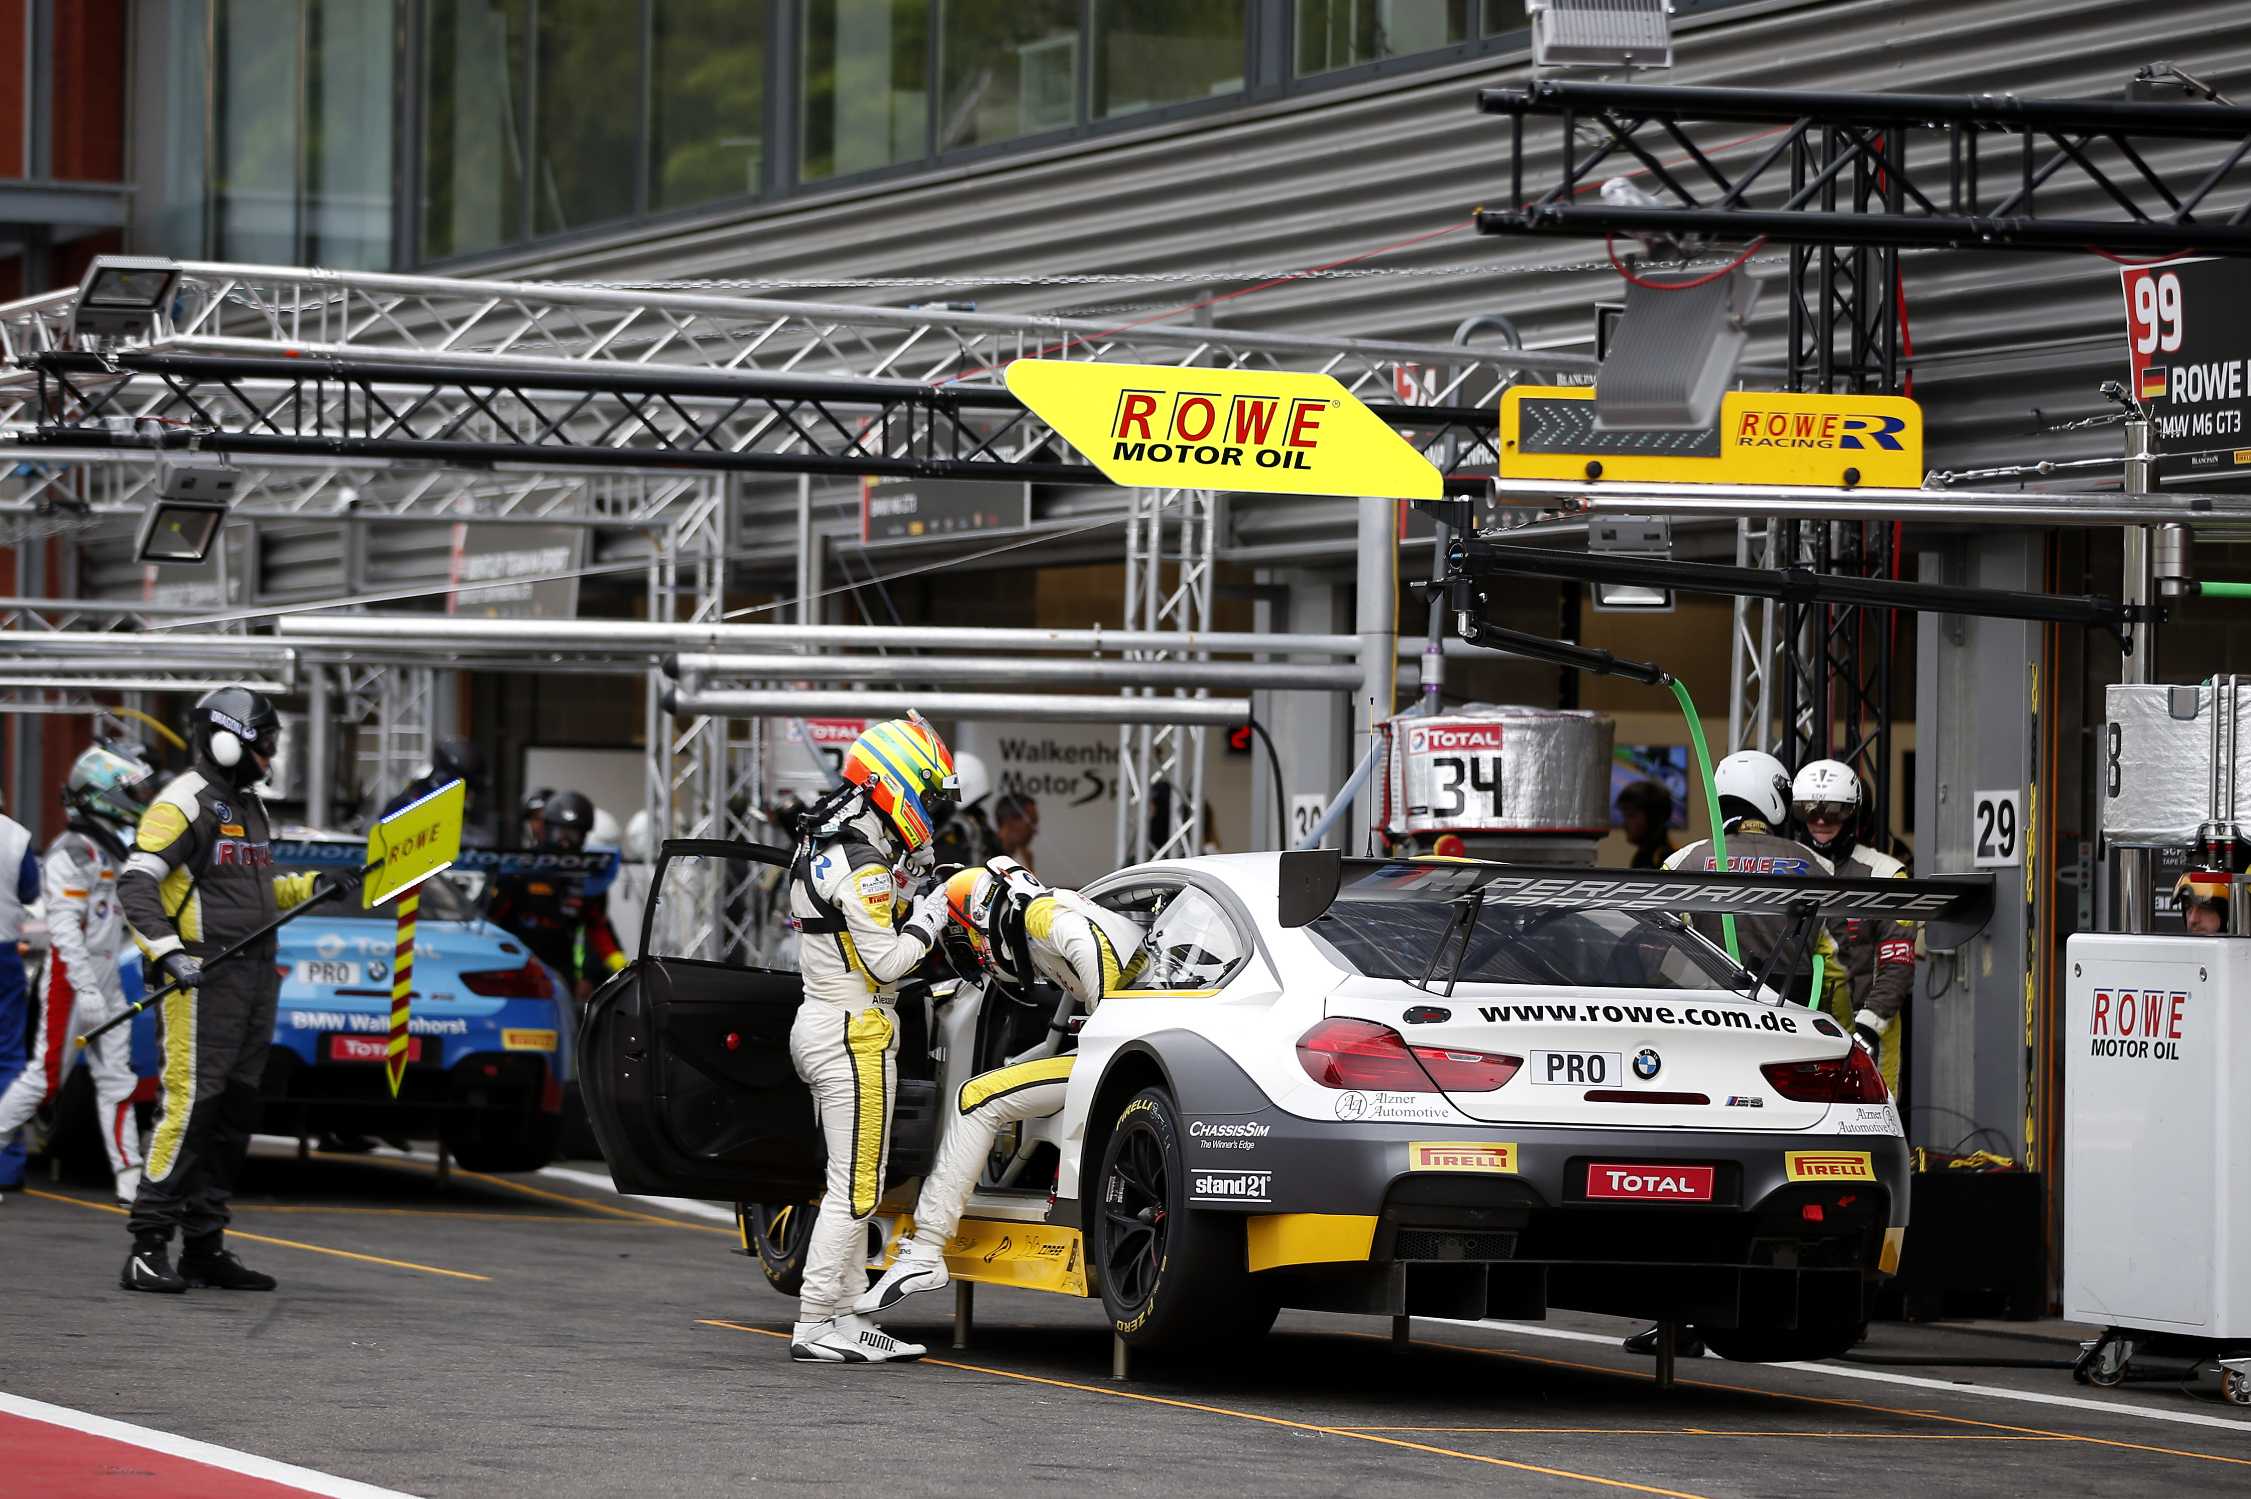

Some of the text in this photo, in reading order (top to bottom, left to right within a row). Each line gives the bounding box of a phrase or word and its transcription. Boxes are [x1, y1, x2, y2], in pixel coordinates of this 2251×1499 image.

[2134, 273, 2183, 354] 99
[2171, 360, 2242, 405] ROWE
[1112, 389, 1330, 448] ROWE
[1738, 411, 1839, 439] ROWE
[2192, 413, 2213, 437] M6
[2216, 410, 2241, 434] GT3
[1112, 441, 1312, 470] MOTOR OIL
[1738, 437, 1833, 449] RACING
[999, 738, 1121, 764] Walkenh
[1429, 729, 1500, 748] TOTAL
[2107, 722, 2122, 798] 8
[1432, 756, 1503, 818] 34
[1976, 799, 2016, 858] 29
[388, 822, 442, 866] ROWE
[463, 849, 613, 871] torsport
[1472, 876, 1960, 911] PERFORMANCE
[308, 962, 350, 983] PRO
[291, 1010, 469, 1034] BMW Walnhorst
[1478, 1004, 1798, 1034] www.rowe.com.de
[2090, 989, 2187, 1040] ROWE
[2091, 1038, 2180, 1061] MOTOR OIL
[1546, 1053, 1606, 1084] PRO
[1370, 1092, 1416, 1106] Alzner
[1368, 1105, 1449, 1119] Automotive
[1855, 1107, 1882, 1121] Alzner
[1836, 1121, 1888, 1135] Automotive
[1200, 1139, 1255, 1151] The Winner's Edge
[1419, 1147, 1509, 1168] PIRELLI
[1794, 1156, 1867, 1176] PIRELLI
[1605, 1170, 1695, 1193] TOTAL
[1116, 1311, 1147, 1333] ZERO
